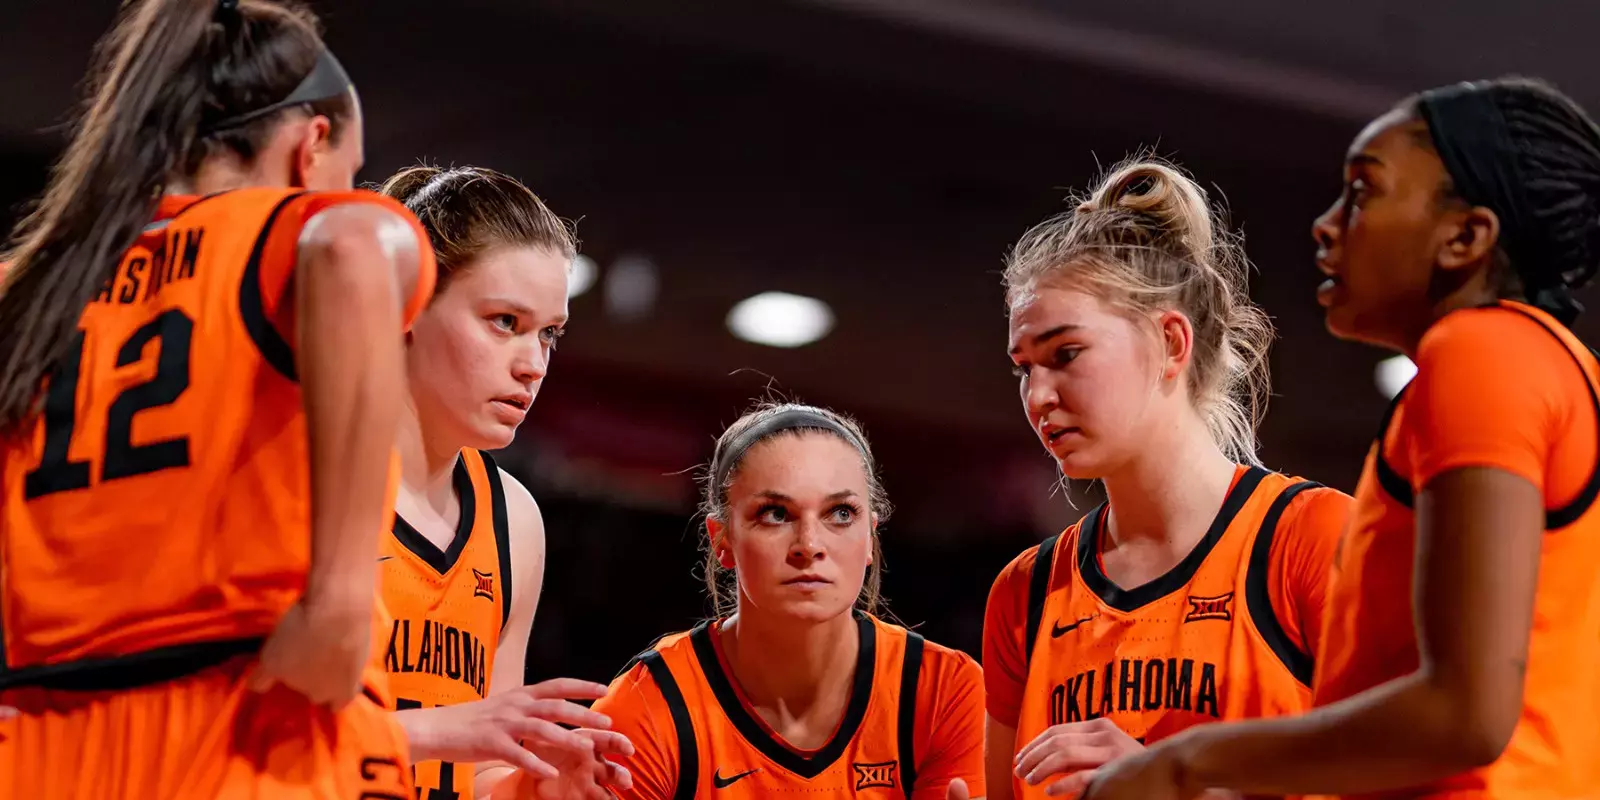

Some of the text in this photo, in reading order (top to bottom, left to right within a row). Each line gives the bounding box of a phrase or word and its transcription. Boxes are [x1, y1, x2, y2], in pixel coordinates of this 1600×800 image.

[24, 307, 194, 502] 12
[1185, 592, 1233, 623] XII
[385, 619, 485, 699] KLAHOMA
[1051, 658, 1219, 726] OKLAHOMA
[853, 761, 897, 791] XII
